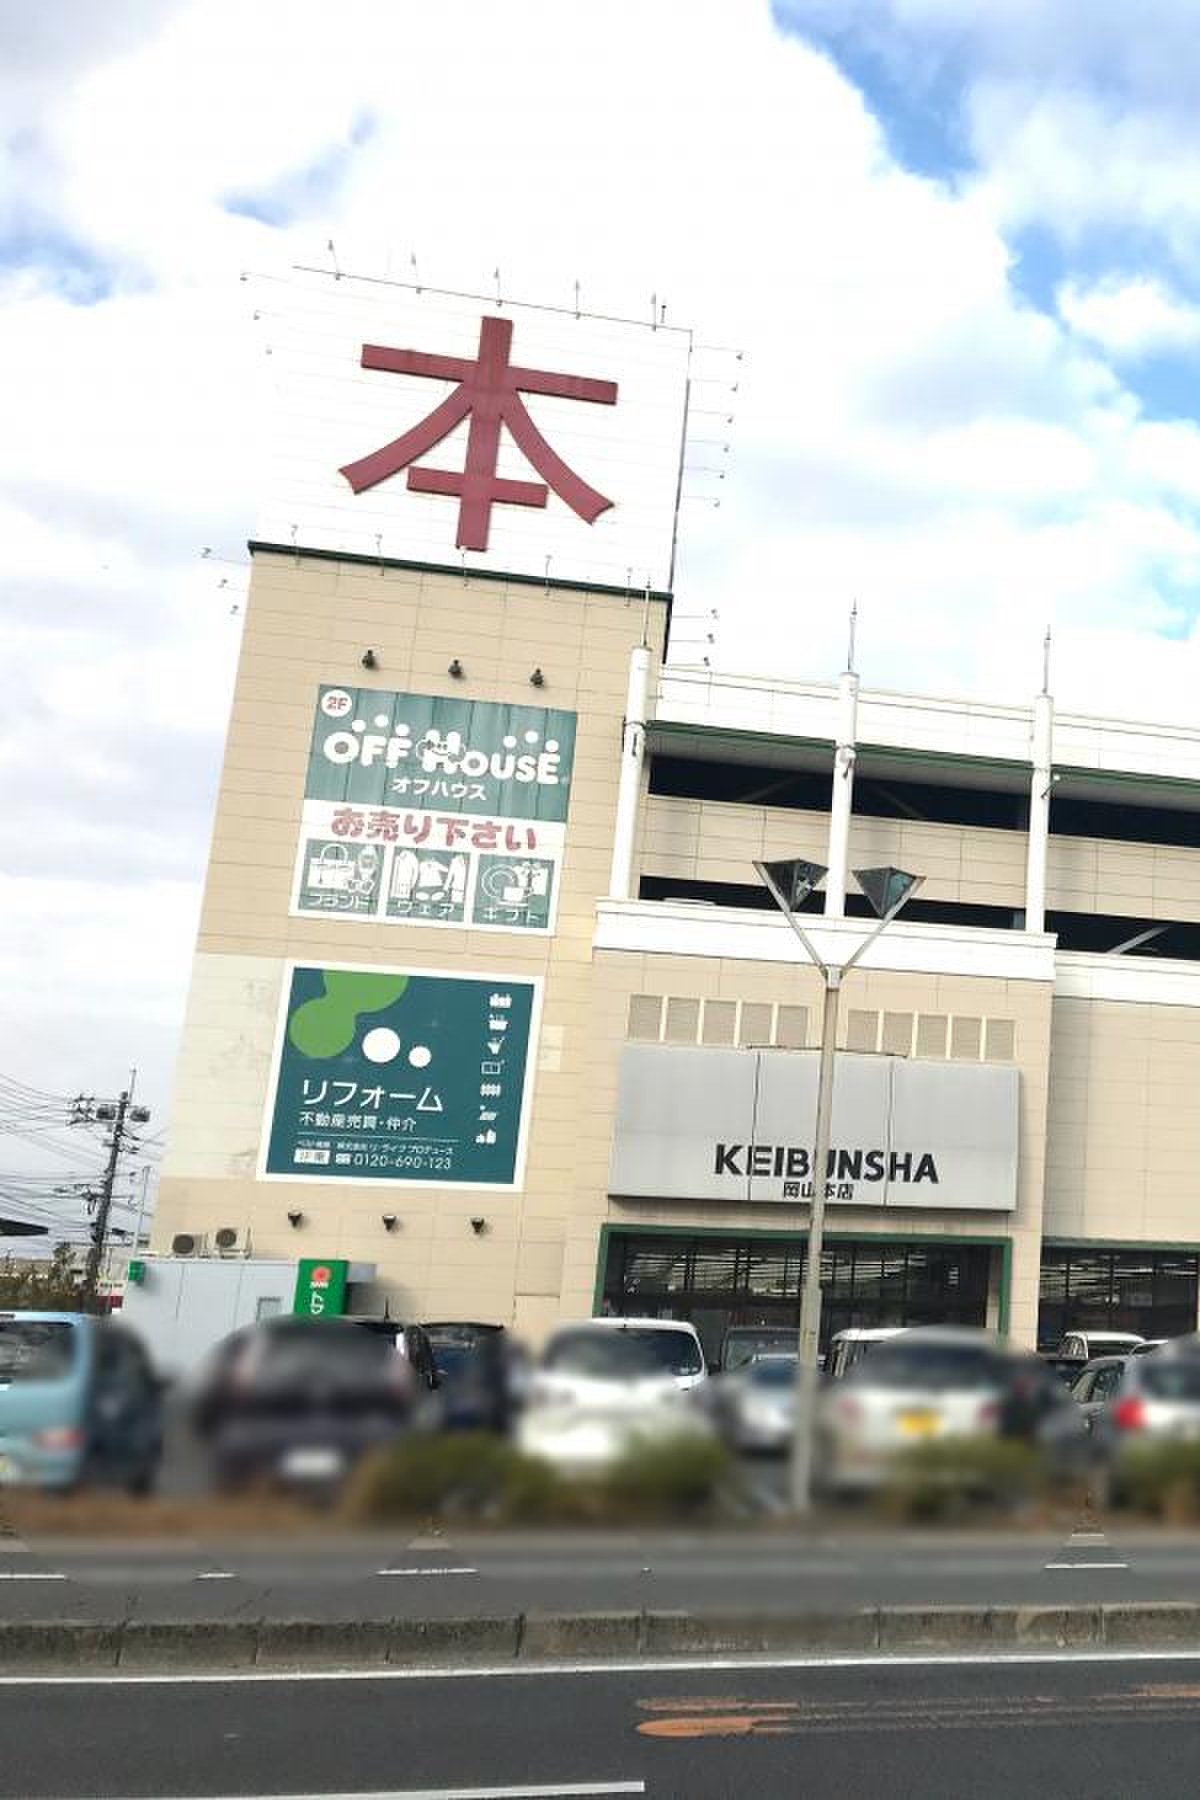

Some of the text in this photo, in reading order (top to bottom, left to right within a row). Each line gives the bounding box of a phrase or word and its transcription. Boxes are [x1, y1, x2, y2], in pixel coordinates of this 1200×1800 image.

[338, 315, 618, 553] 本
[326, 696, 348, 711] 2F
[323, 729, 561, 785] OFF HOUSE
[391, 777, 488, 801] オフハウス
[331, 806, 537, 851] お売り下さい
[303, 1079, 444, 1112] リフォーム
